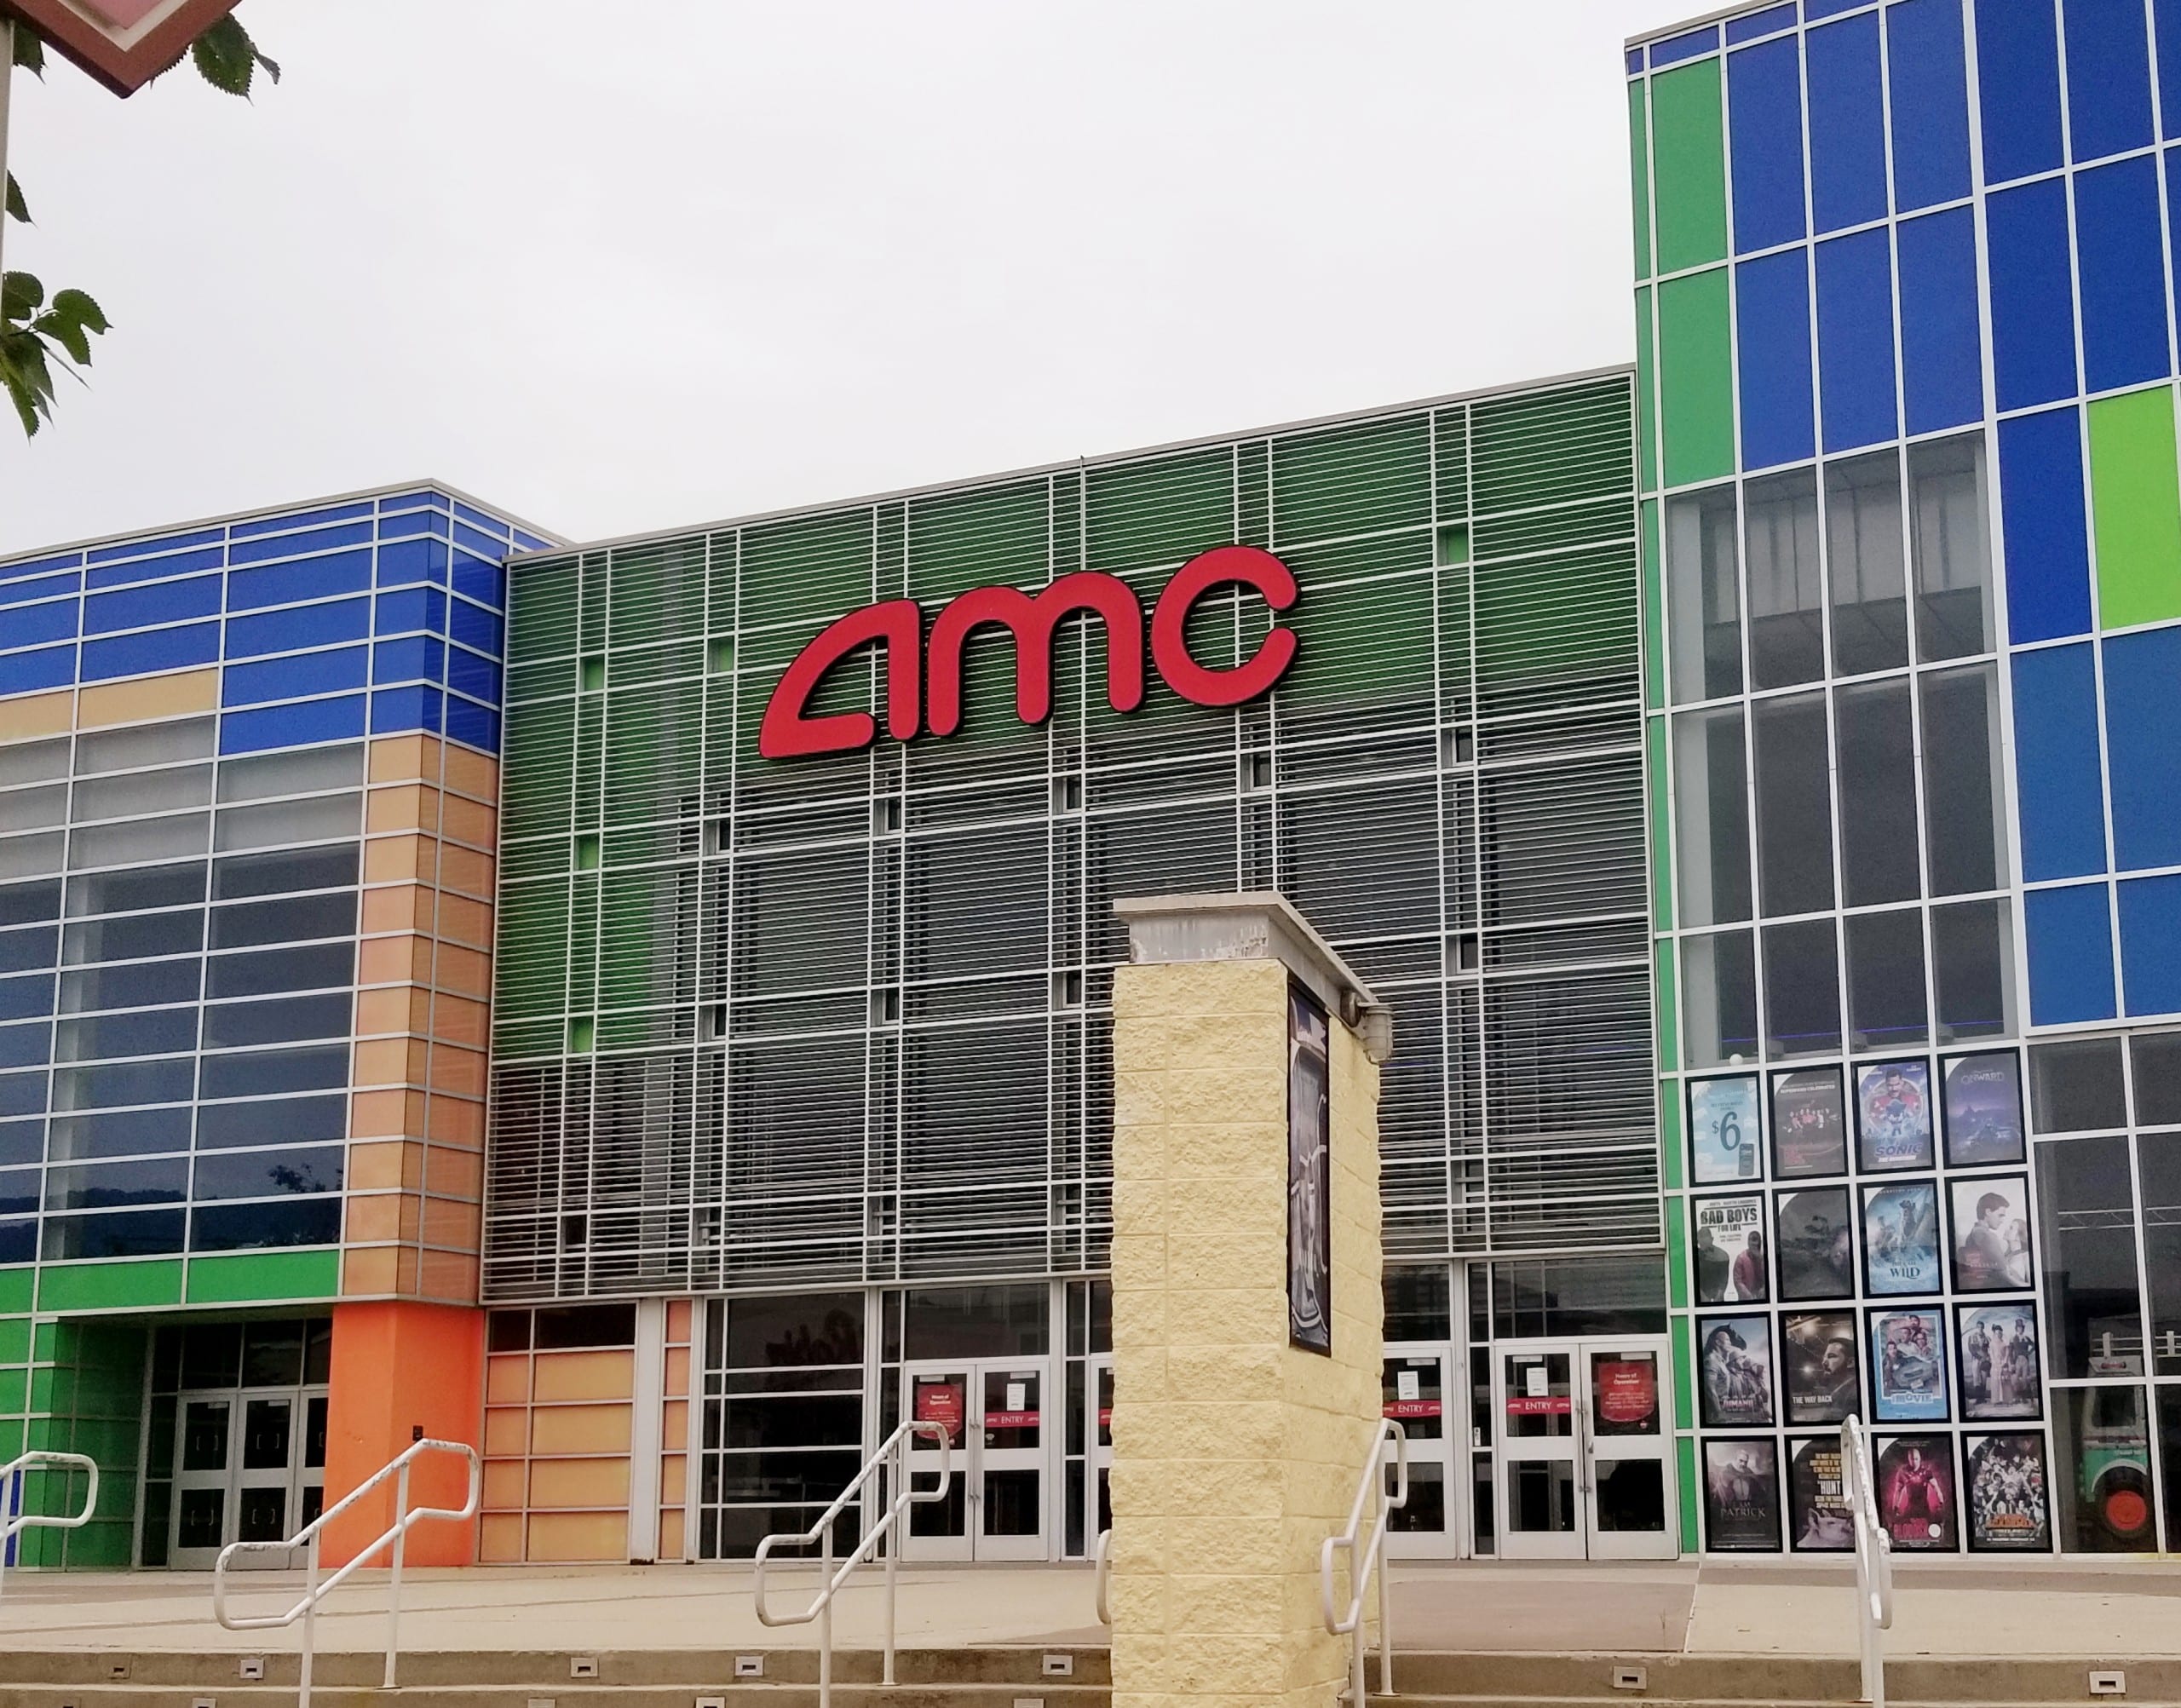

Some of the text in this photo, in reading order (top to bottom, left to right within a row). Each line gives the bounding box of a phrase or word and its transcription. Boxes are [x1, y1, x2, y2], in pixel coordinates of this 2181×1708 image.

[759, 544, 1300, 758] amc
[1874, 1142, 1923, 1156] SONIC
[1700, 1207, 1757, 1224] BAD BOYS
[1890, 1267, 1920, 1280] WILD
[1804, 1395, 1816, 1404] WAY
[1817, 1395, 1833, 1403] BACK
[1398, 1404, 1424, 1413] ENTRY
[1525, 1401, 1551, 1410] ENTRY
[1001, 1415, 1024, 1424] ENTRY
[1720, 1507, 1766, 1517] PATRICK
